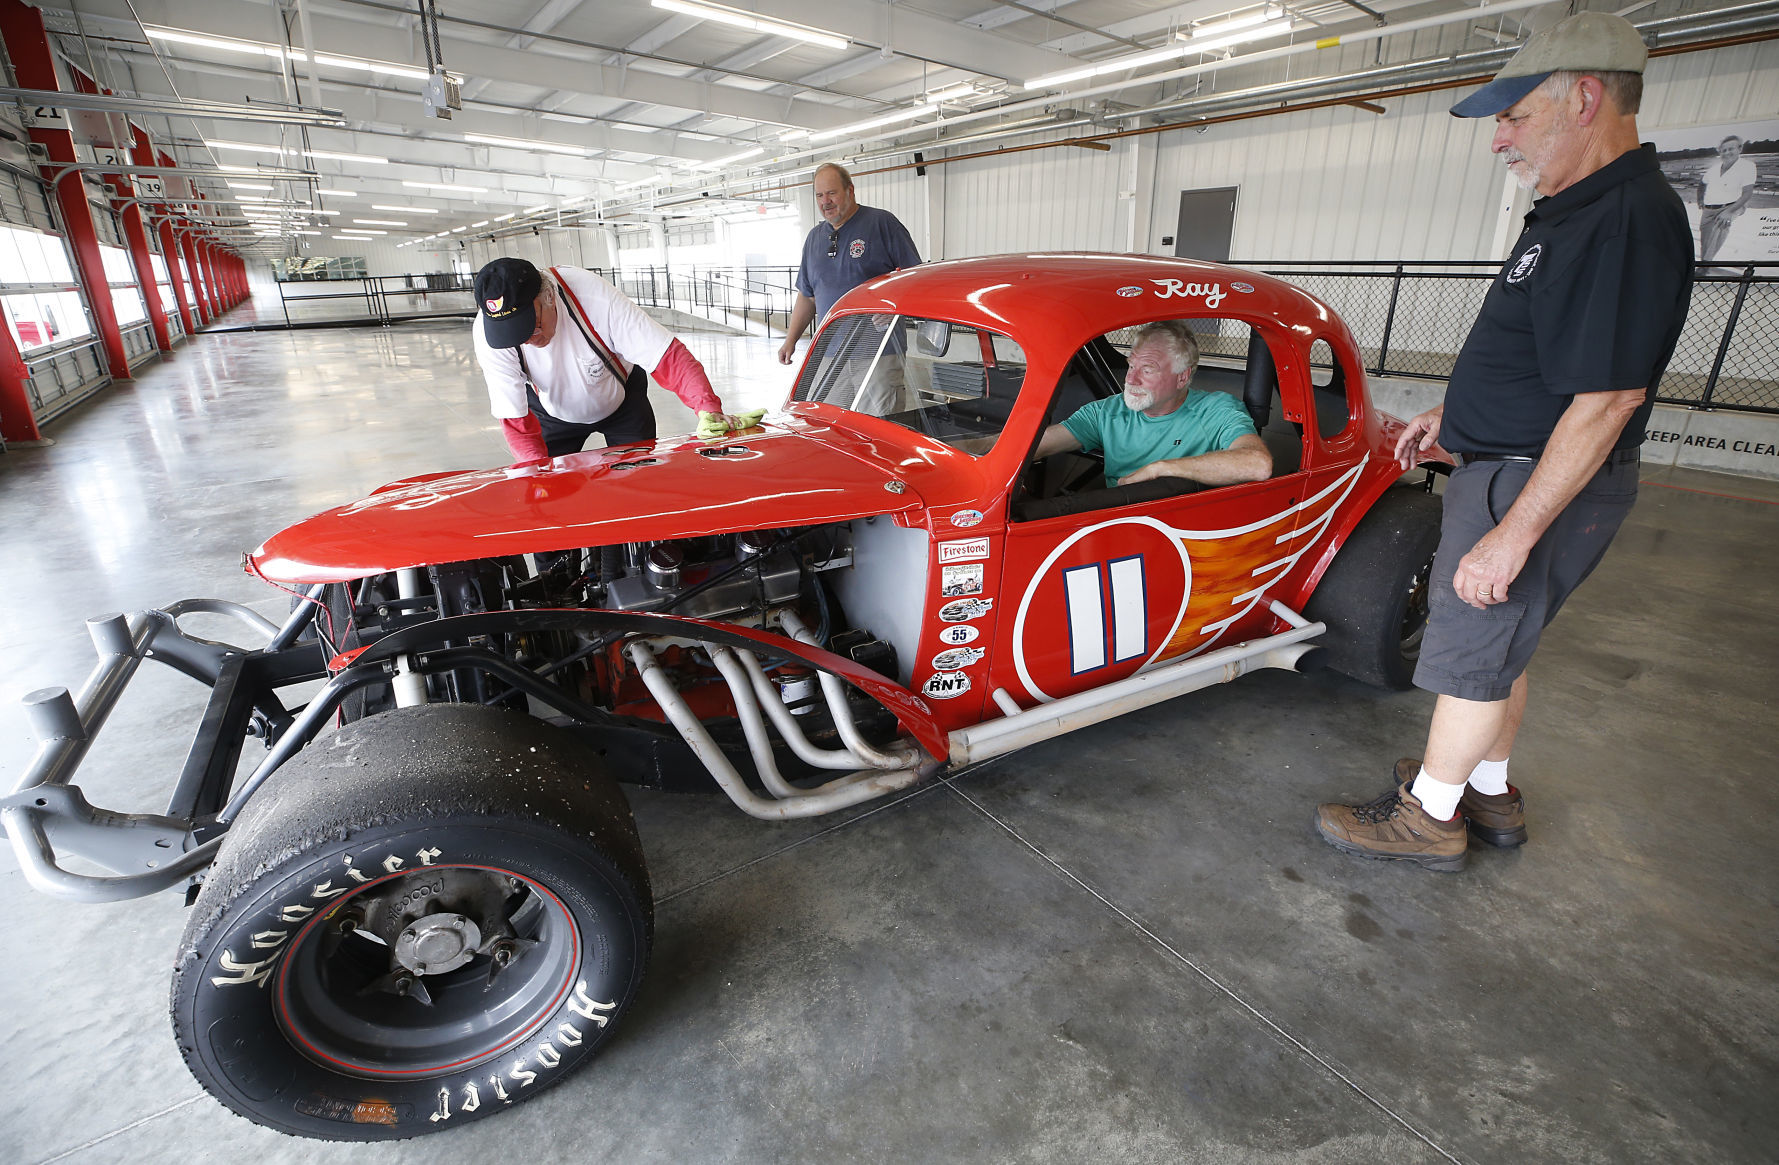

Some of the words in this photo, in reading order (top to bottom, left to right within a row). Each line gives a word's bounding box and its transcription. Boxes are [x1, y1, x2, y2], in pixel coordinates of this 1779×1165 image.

[146, 183, 161, 193] 19
[1148, 278, 1228, 309] Ray
[1683, 435, 1726, 450] AREA
[1733, 440, 1779, 456] CLEA
[943, 544, 986, 558] Firestone
[1061, 552, 1148, 677] 11
[951, 628, 967, 641] 55
[929, 678, 965, 692] RNT
[209, 846, 443, 989] Hoosier
[429, 979, 617, 1123] Hoosier
